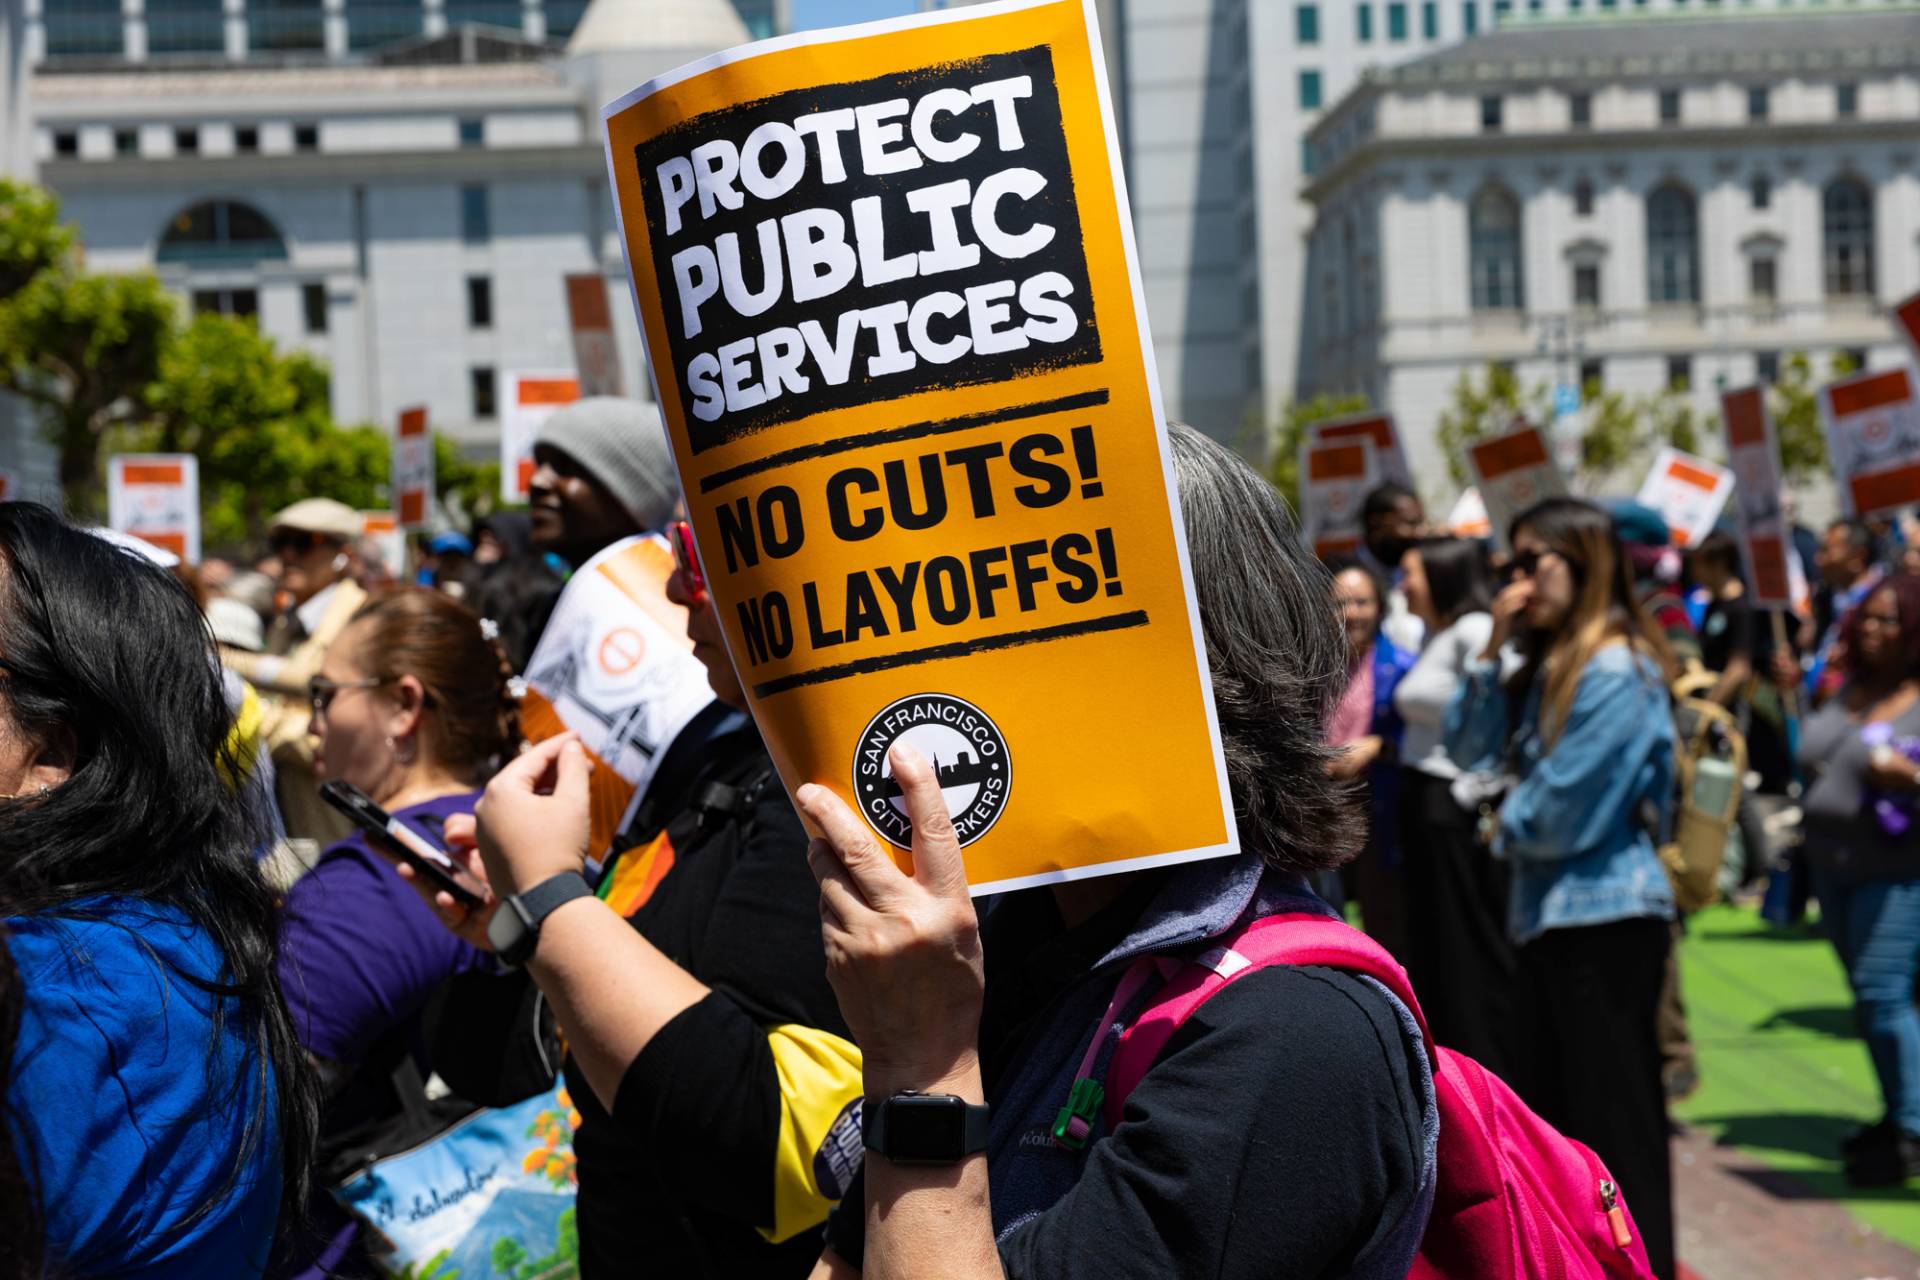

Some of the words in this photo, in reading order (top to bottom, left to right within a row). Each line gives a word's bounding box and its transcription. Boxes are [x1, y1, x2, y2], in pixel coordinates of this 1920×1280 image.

[656, 75, 1033, 236] PROTECT
[671, 167, 1056, 340] PUBLIC
[686, 271, 1079, 423] SERVICES
[715, 485, 805, 574] NO
[825, 425, 1104, 542] CUTS!
[737, 591, 794, 667] NO
[802, 527, 1123, 650] LAYOFFS!
[861, 730, 889, 776] SAN
[883, 702, 997, 757] FRANCISCO
[871, 797, 912, 838] CITY
[953, 776, 1003, 839] RKERS
[830, 1111, 865, 1176] BUDG
